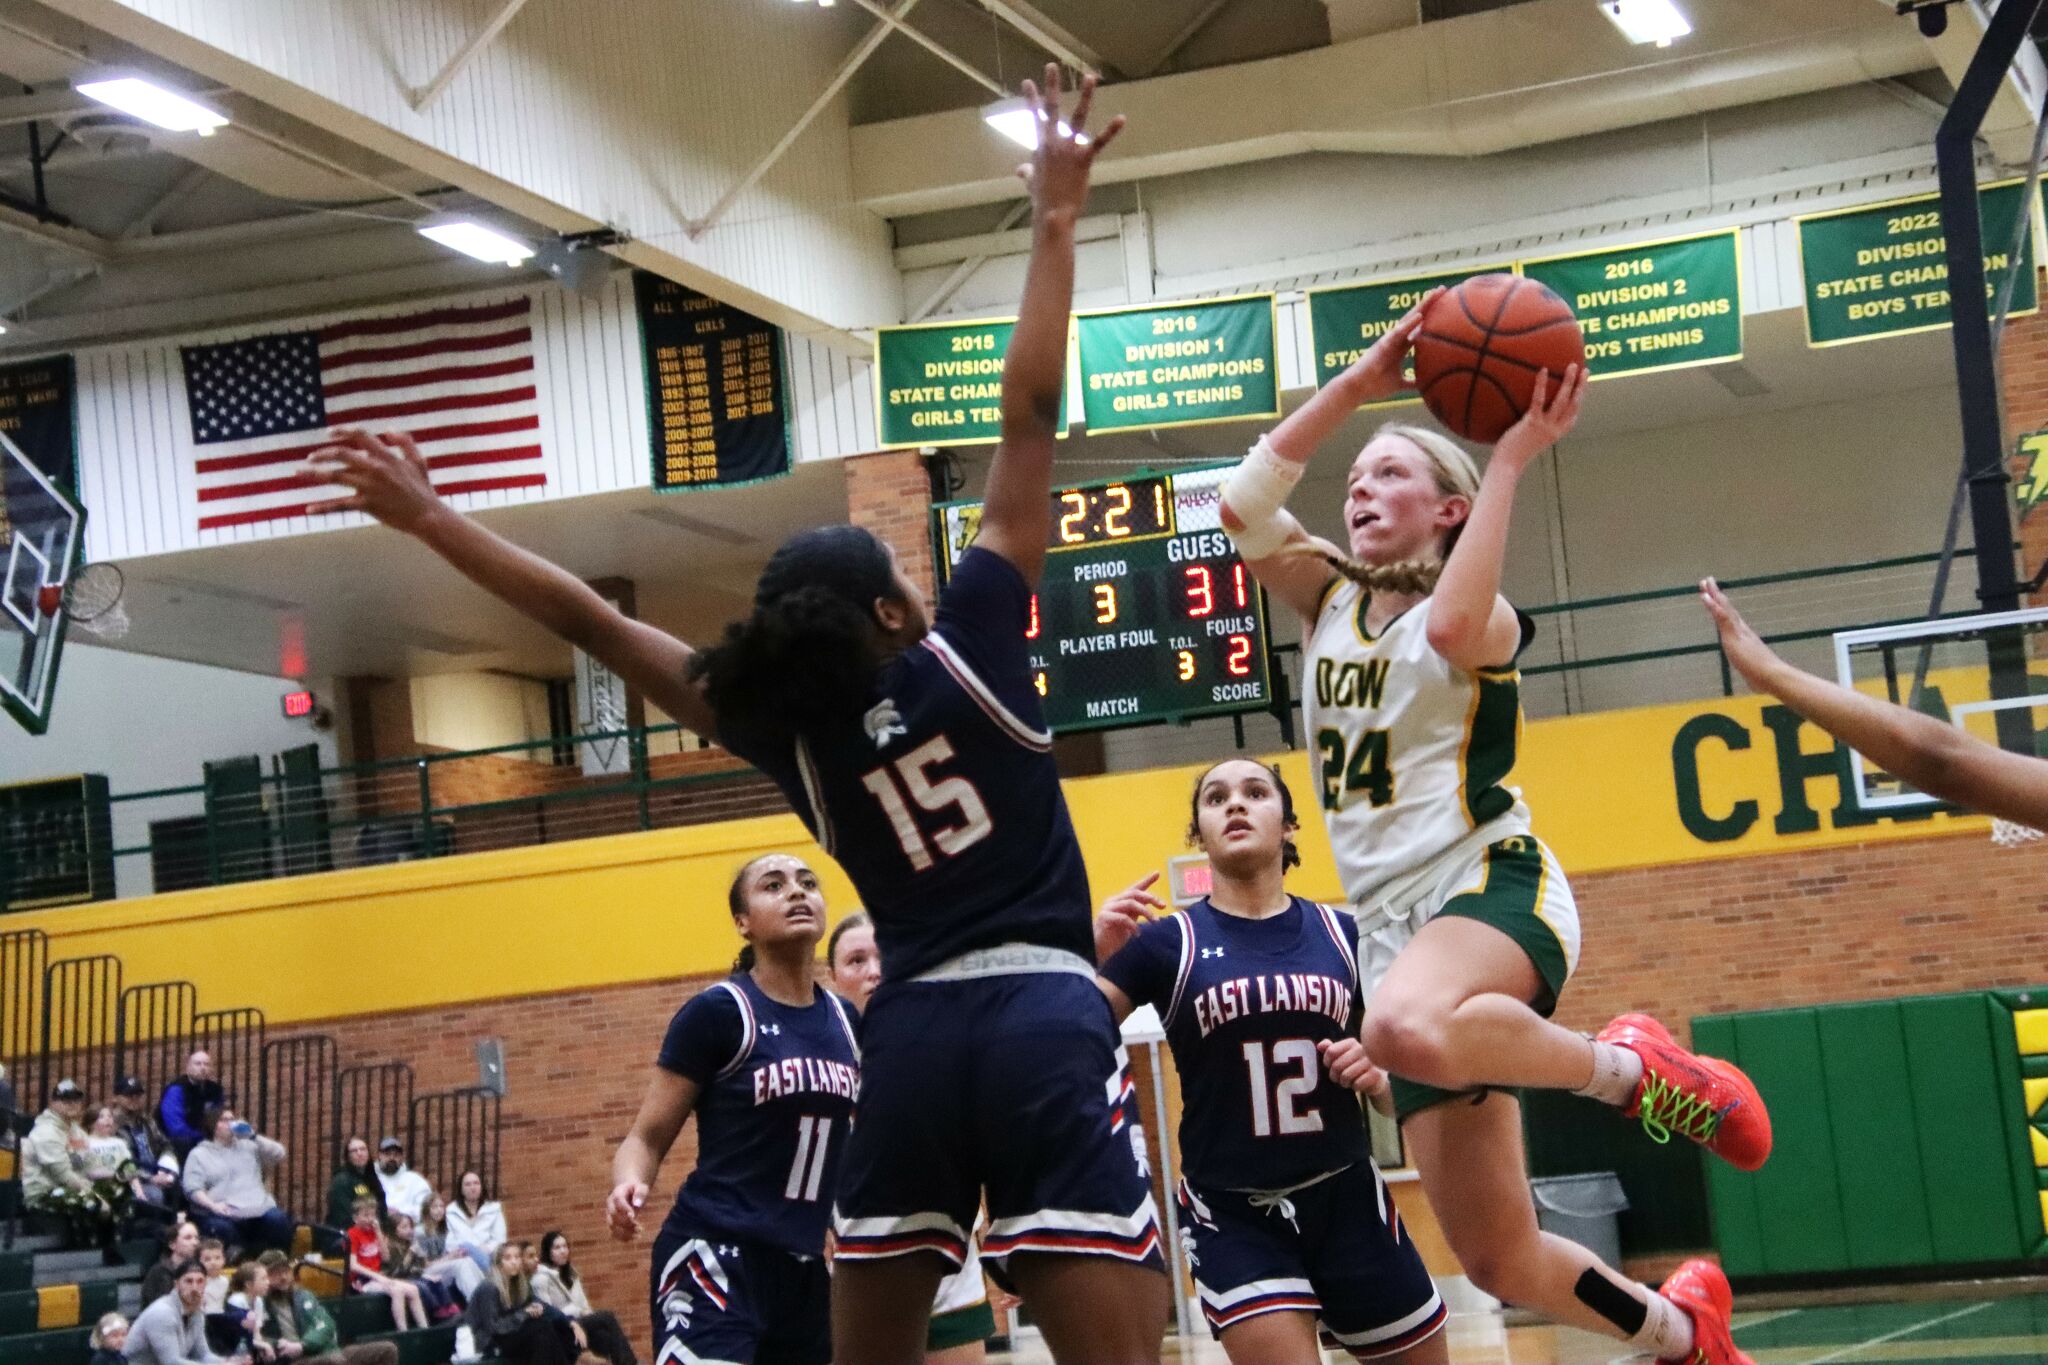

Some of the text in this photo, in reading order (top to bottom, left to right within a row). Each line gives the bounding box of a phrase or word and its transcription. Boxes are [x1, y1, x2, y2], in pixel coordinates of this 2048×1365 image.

[1888, 212, 1940, 234] 2022
[1605, 259, 1653, 279] 2016
[1577, 280, 1686, 309] DIVISION 2
[1817, 275, 1884, 298] STATE
[1607, 299, 1730, 330] CHAMPIONS
[1849, 297, 1906, 320] BOYS
[1152, 316, 1196, 334] 2016
[952, 334, 994, 352] 2015
[1126, 338, 1224, 362] DIVISION 1
[1584, 329, 1704, 359] OYS TENNIS
[1090, 358, 1264, 390] STATE CHAMPIONS
[890, 387, 945, 404] STATE
[1114, 385, 1243, 412] GIRLS TENNIS
[912, 408, 1003, 426] GIRLS TEN
[1061, 484, 1165, 542] 2:21
[1074, 560, 1127, 581] PERIOD
[1095, 584, 1116, 624] 3
[1186, 565, 1246, 617] 31
[1060, 629, 1158, 655] PLAYER FOUL
[1206, 616, 1254, 640] FOULS
[1179, 651, 1194, 680] 3
[1229, 636, 1250, 675] 2
[1212, 682, 1261, 702] SCORE
[1316, 658, 1390, 708] DOW
[285, 694, 311, 716] EXIT
[1087, 699, 1138, 718] MATCH
[1317, 727, 1394, 813] 24
[860, 733, 993, 872] 15
[1194, 976, 1250, 1038] EAST
[754, 1058, 806, 1106] EAST
[1243, 1038, 1324, 1136] 12
[785, 1116, 832, 1201] 11
